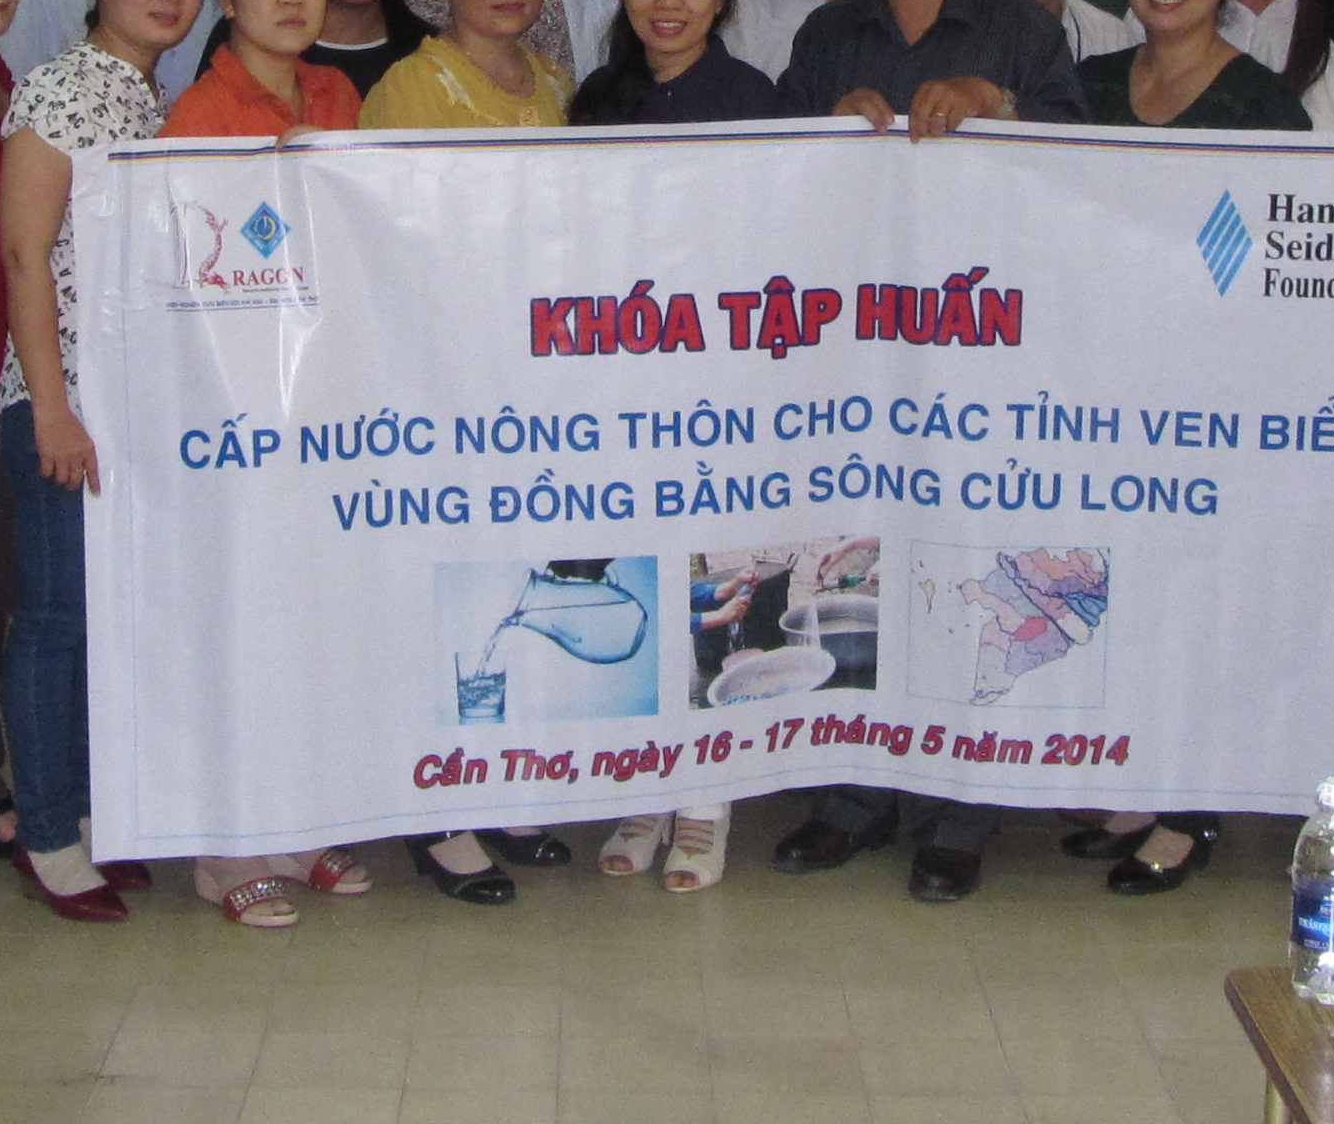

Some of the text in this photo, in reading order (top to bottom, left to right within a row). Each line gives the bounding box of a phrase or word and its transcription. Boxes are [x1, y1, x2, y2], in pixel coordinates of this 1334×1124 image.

[530, 265, 1022, 358] KHÓA TẬP HUẤN
[180, 413, 282, 469] CẤP
[300, 407, 436, 464] NƯỚC
[455, 405, 601, 454] NÔNG
[618, 398, 755, 449] THÔN
[773, 395, 874, 441] CHO
[888, 392, 992, 442] CÁC
[1006, 390, 1121, 443] TỈNH
[1139, 408, 1240, 449] VEN
[332, 452, 1220, 530] VÙNG ĐỒNG BẰNG SÔNG CỬU LONG
[413, 747, 488, 789] Cần
[500, 749, 579, 784] Thơ,
[591, 740, 681, 781] ngày
[694, 731, 733, 764] 16
[765, 718, 804, 751] 17
[810, 714, 914, 756] tháng
[920, 725, 946, 755] 5
[951, 731, 1034, 765] năm
[1041, 734, 1131, 766] 2014
